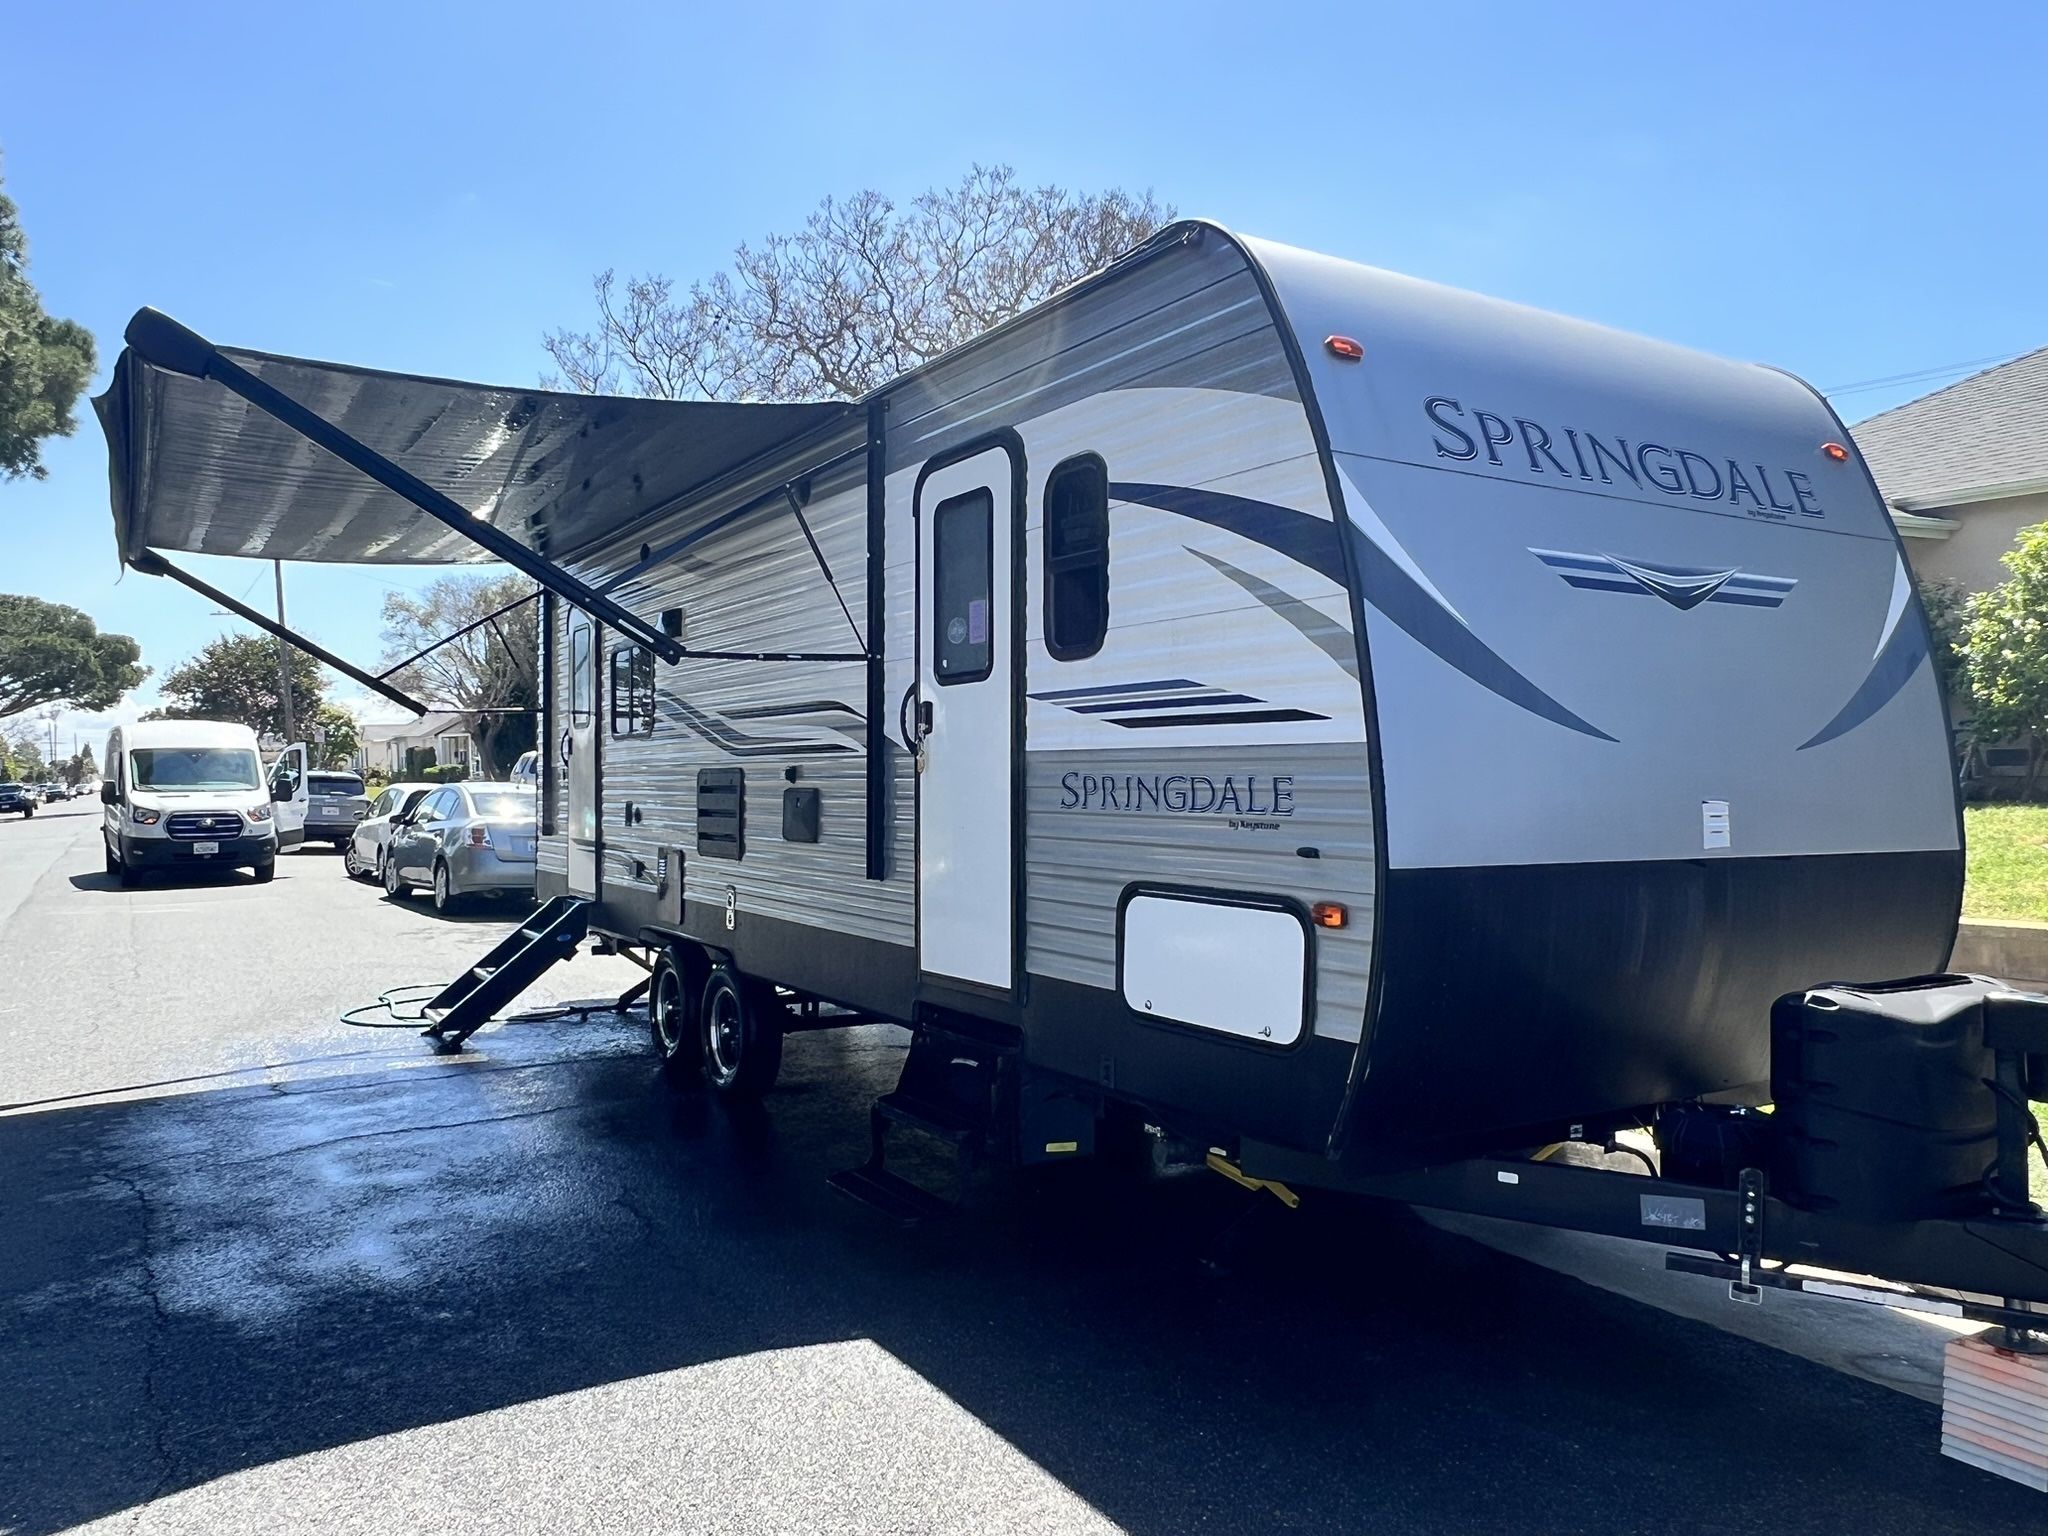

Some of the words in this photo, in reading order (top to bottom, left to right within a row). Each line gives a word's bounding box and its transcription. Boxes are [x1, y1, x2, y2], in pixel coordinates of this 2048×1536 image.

[1422, 395, 1825, 519] SPRINGDALE
[1060, 771, 1295, 816] SPRINGDALE
[1229, 819, 1239, 830] by
[1240, 820, 1280, 831] Keystone
